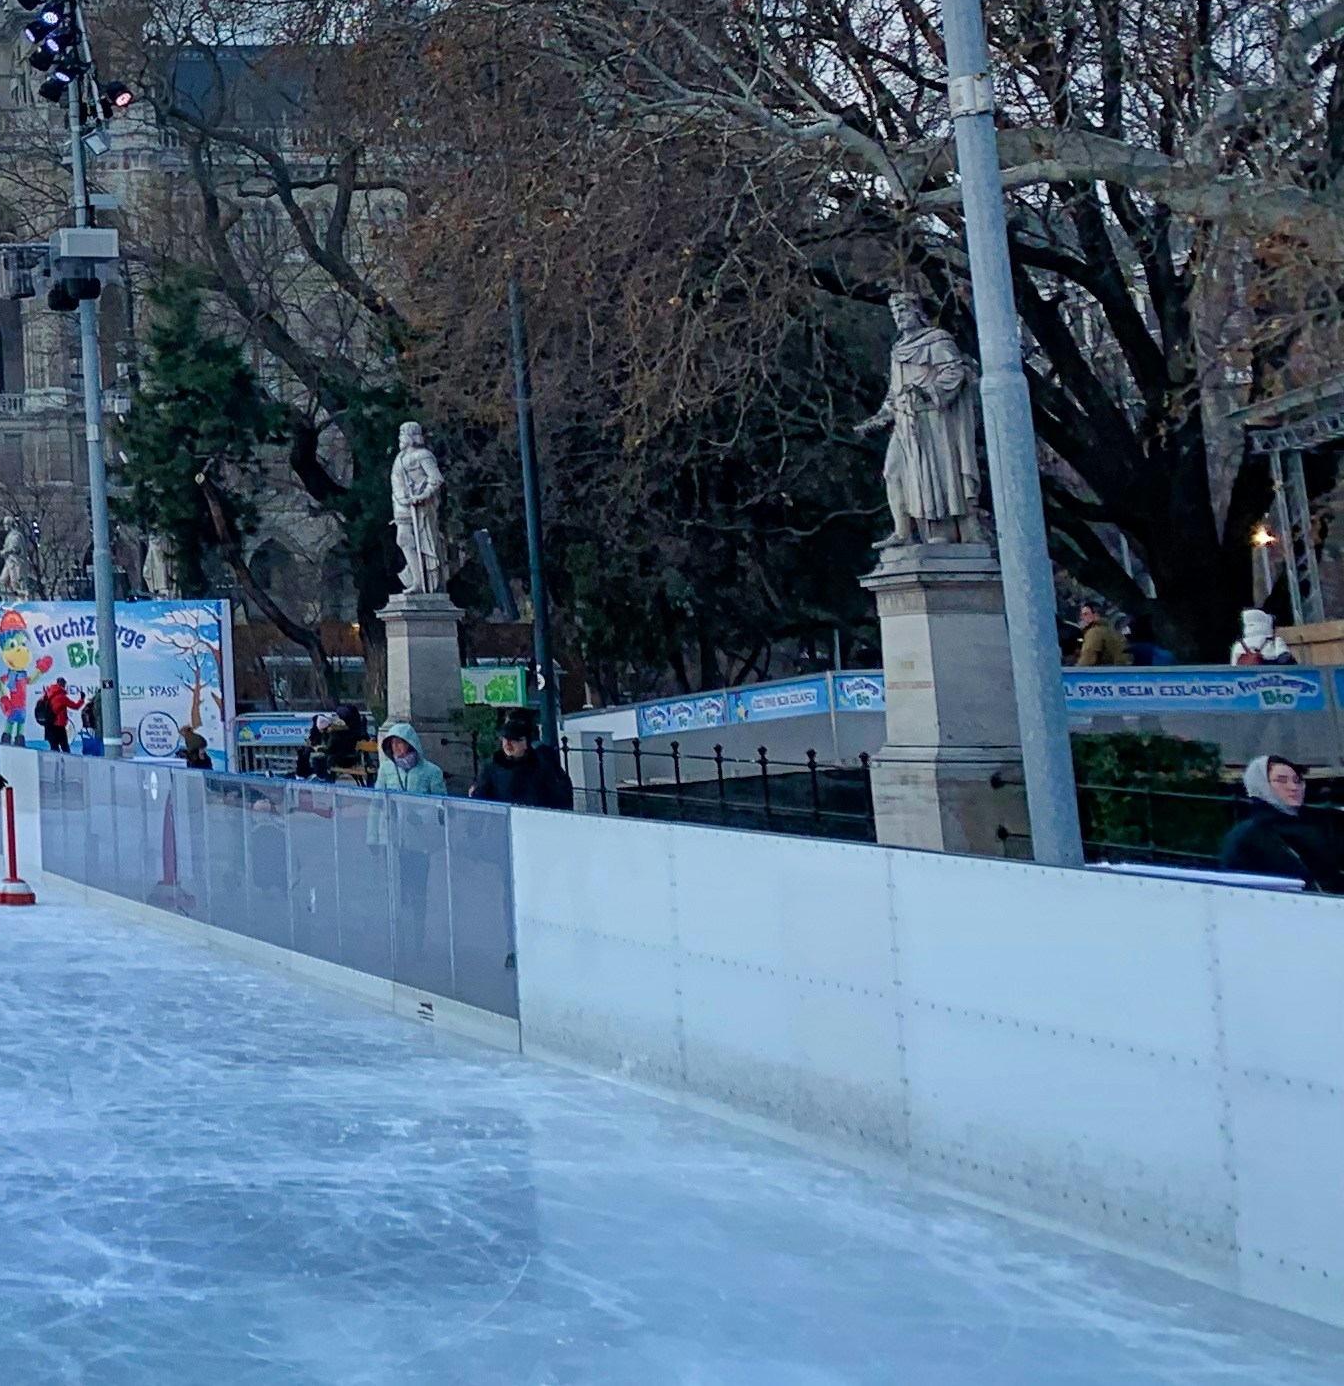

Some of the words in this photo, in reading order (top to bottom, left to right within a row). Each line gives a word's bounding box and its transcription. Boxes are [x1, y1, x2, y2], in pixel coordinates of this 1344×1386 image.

[66, 639, 101, 669] Bi
[1078, 685, 1113, 698] SPASS
[1159, 685, 1234, 697] EISLAUFEN
